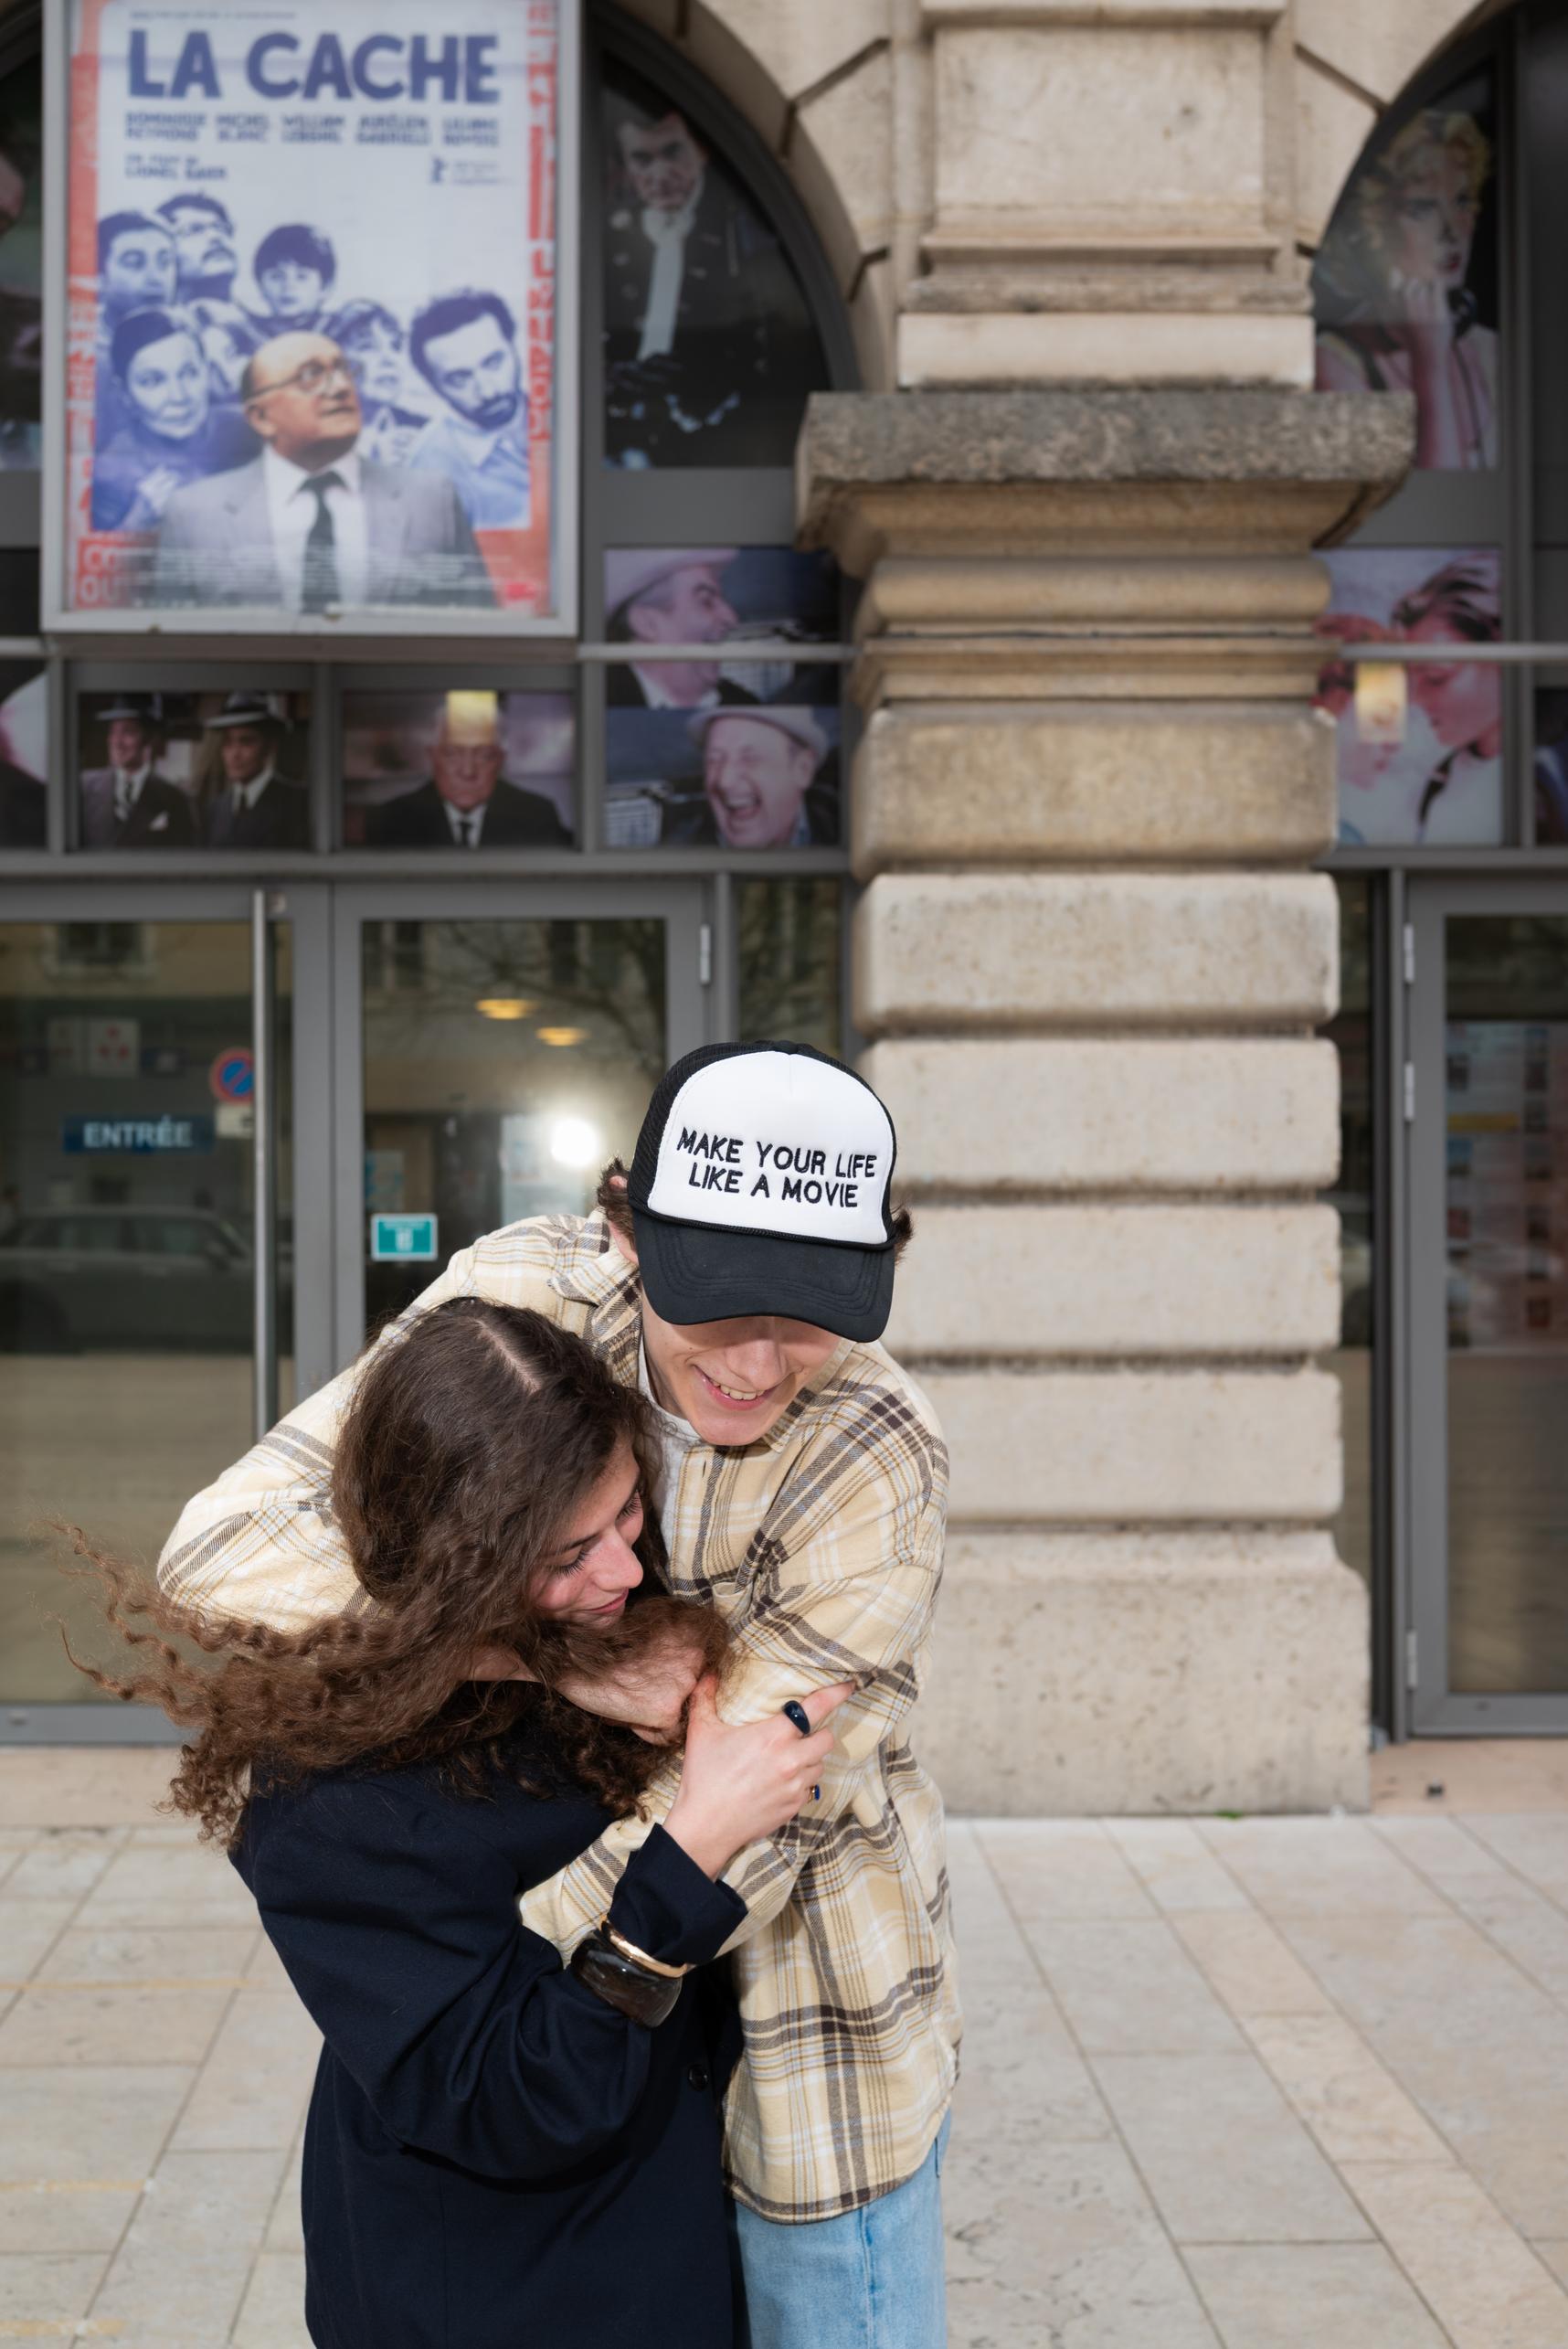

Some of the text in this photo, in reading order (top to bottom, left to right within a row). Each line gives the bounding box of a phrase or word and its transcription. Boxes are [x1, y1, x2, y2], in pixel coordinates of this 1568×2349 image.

[129, 29, 500, 103] LA CACHE
[126, 113, 206, 126] DOMINIQUE
[282, 115, 344, 128] WILLIAM
[84, 1114, 193, 1148] ENTRÉE
[676, 1126, 877, 1179] MAKE YOUR LIFE
[688, 1162, 858, 1208] LIKE A MOVIE
